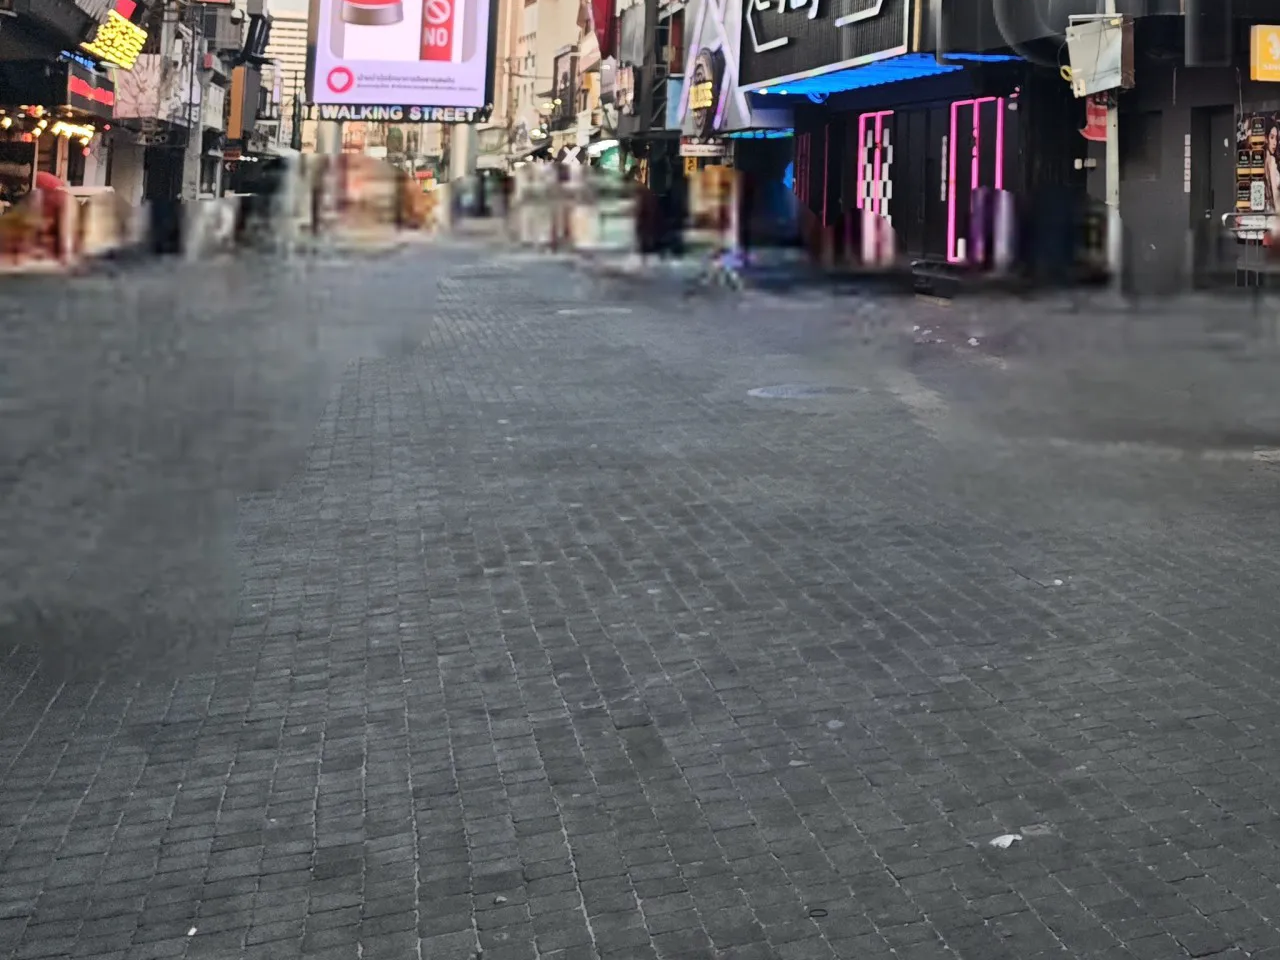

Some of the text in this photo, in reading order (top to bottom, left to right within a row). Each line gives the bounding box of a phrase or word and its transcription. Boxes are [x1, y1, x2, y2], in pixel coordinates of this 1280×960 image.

[423, 27, 449, 47] NO
[322, 104, 477, 122] WALKING STREET
